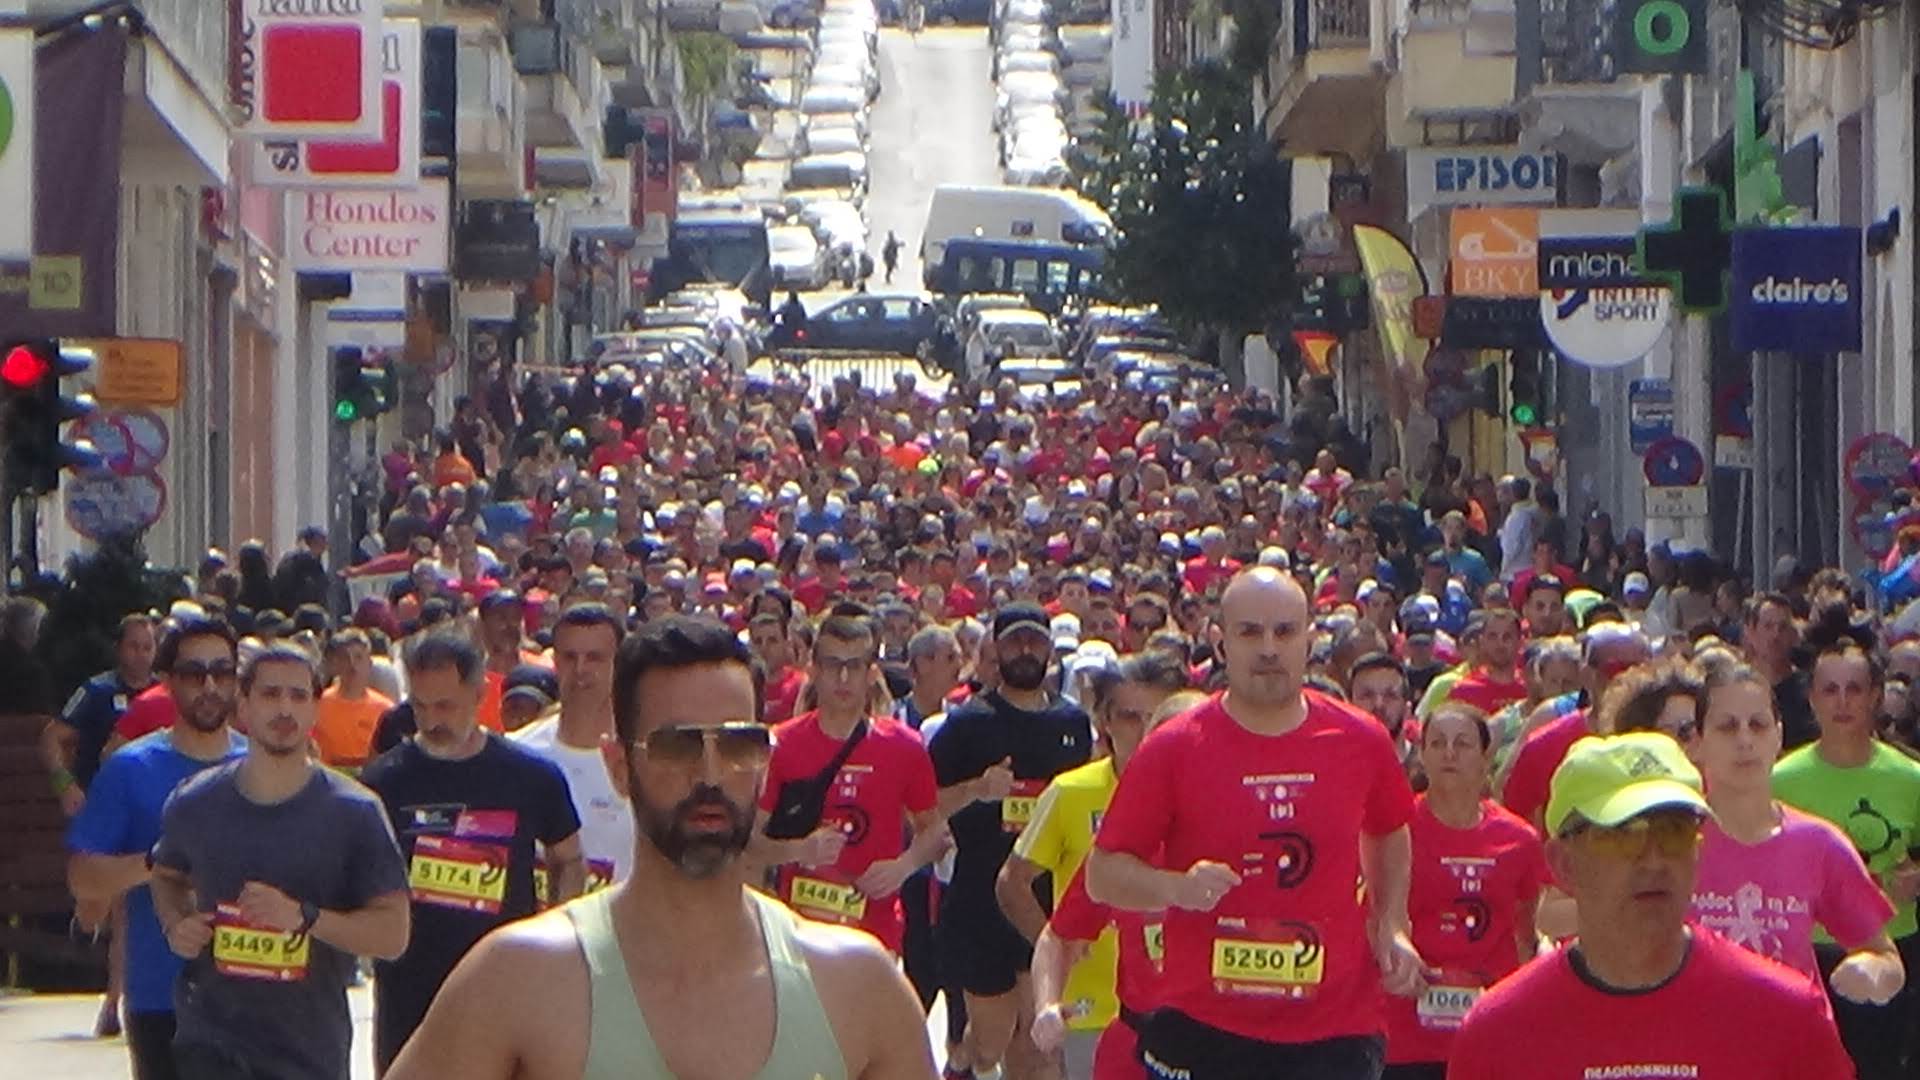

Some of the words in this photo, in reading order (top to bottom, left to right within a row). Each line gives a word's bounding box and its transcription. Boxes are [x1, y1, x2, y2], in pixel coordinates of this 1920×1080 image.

[304, 192, 436, 223] Hondos
[304, 226, 420, 257] Center
[1464, 266, 1531, 291] BKY
[1752, 275, 1849, 304] claire's
[1594, 303, 1659, 321] SPORT
[419, 861, 471, 885] 5174
[221, 932, 274, 955] 5449
[1223, 946, 1285, 970] 5250
